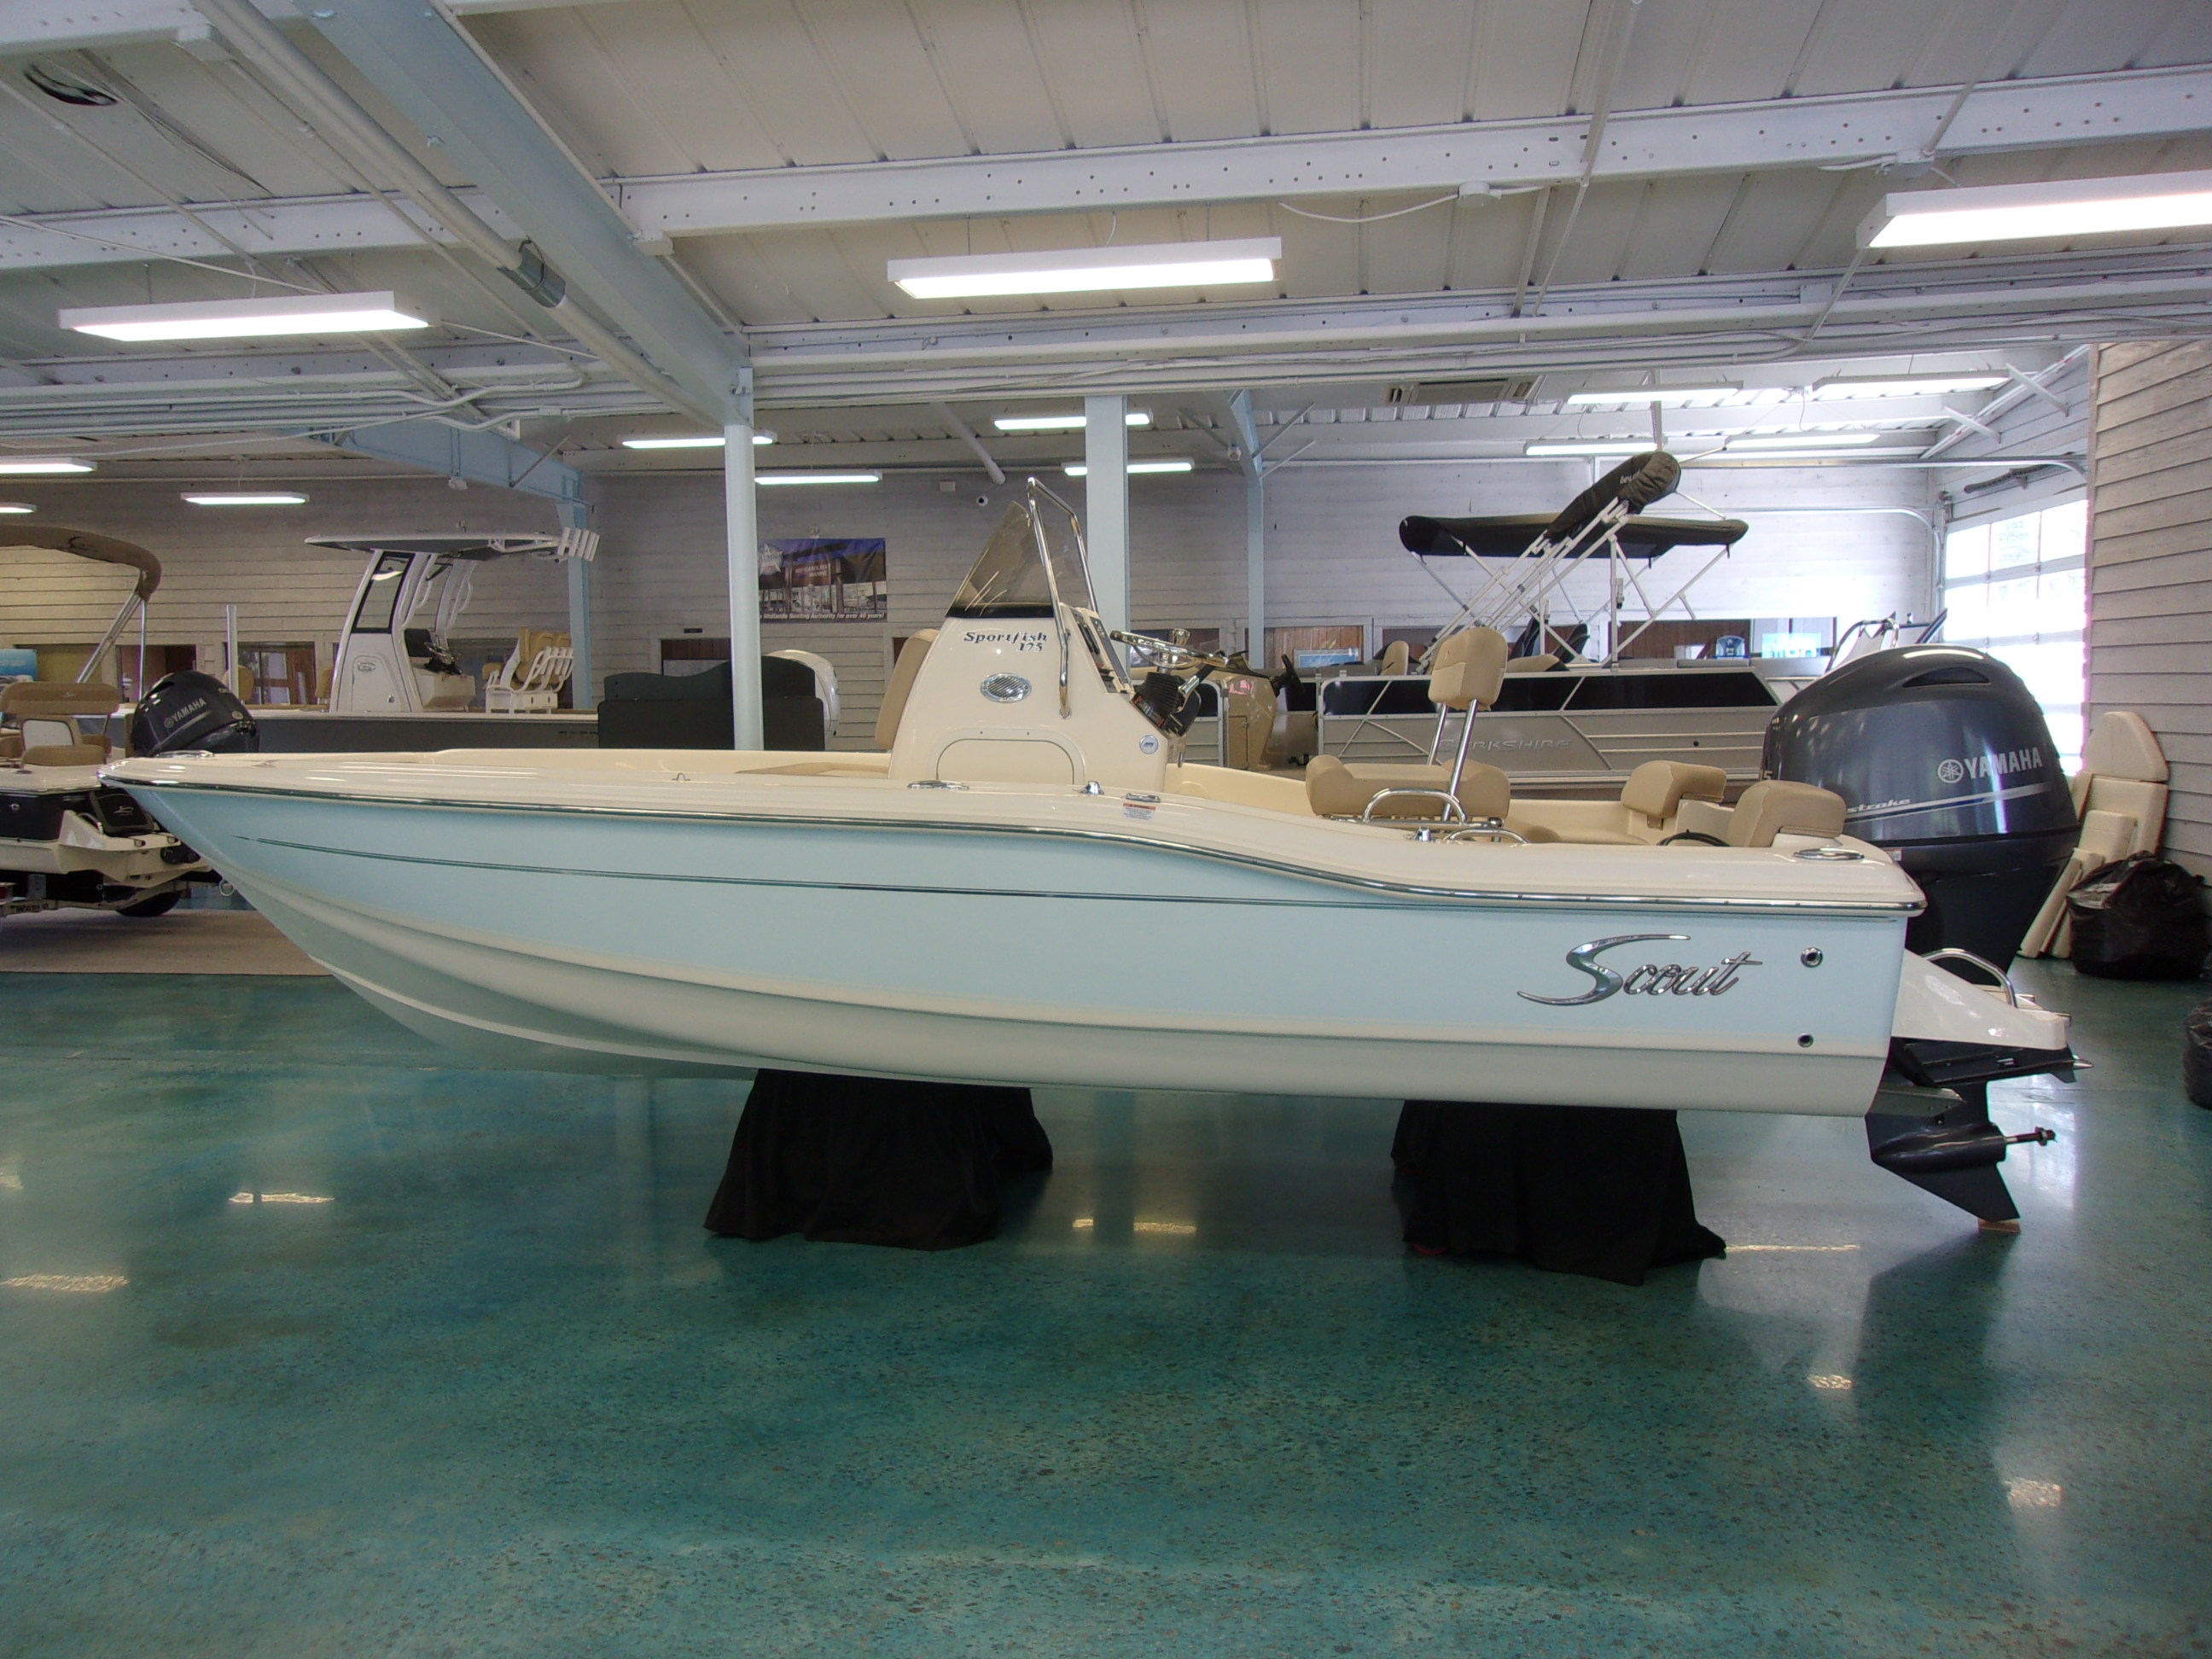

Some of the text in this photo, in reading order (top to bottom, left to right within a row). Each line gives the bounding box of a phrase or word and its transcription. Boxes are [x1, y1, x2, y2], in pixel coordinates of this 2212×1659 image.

[963, 632, 1048, 644] Sportfish
[1018, 643, 1044, 652] 175
[172, 697, 207, 722] YAMAHA
[1437, 738, 1571, 752] BRKSHIRE
[1964, 747, 2043, 780] YAMAHA
[1516, 933, 1764, 1006] Scout
